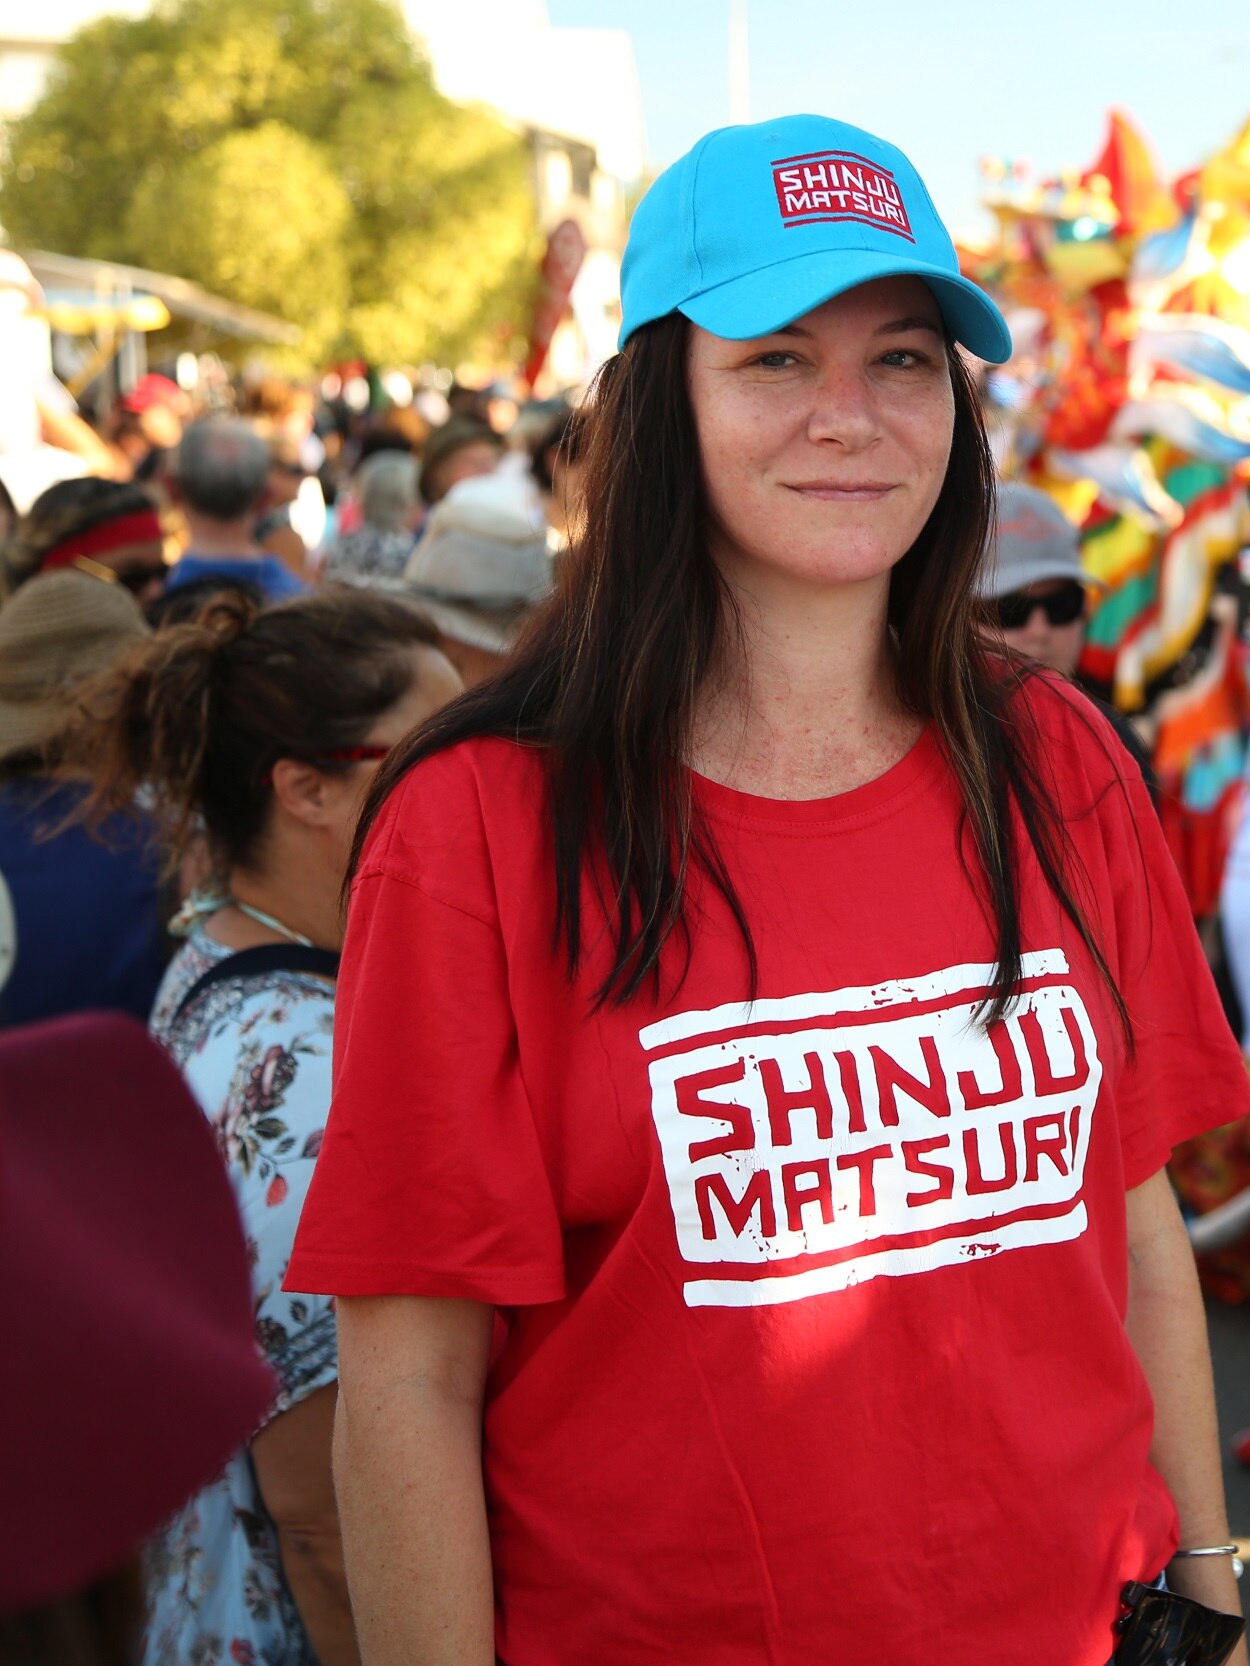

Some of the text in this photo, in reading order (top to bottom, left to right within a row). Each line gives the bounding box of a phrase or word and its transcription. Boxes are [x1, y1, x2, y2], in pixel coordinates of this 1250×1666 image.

[779, 164, 901, 207] SHINJU
[785, 190, 906, 227] MATSURI
[673, 1007, 1091, 1164] SHINJU
[694, 1105, 1082, 1240] MATSURI
